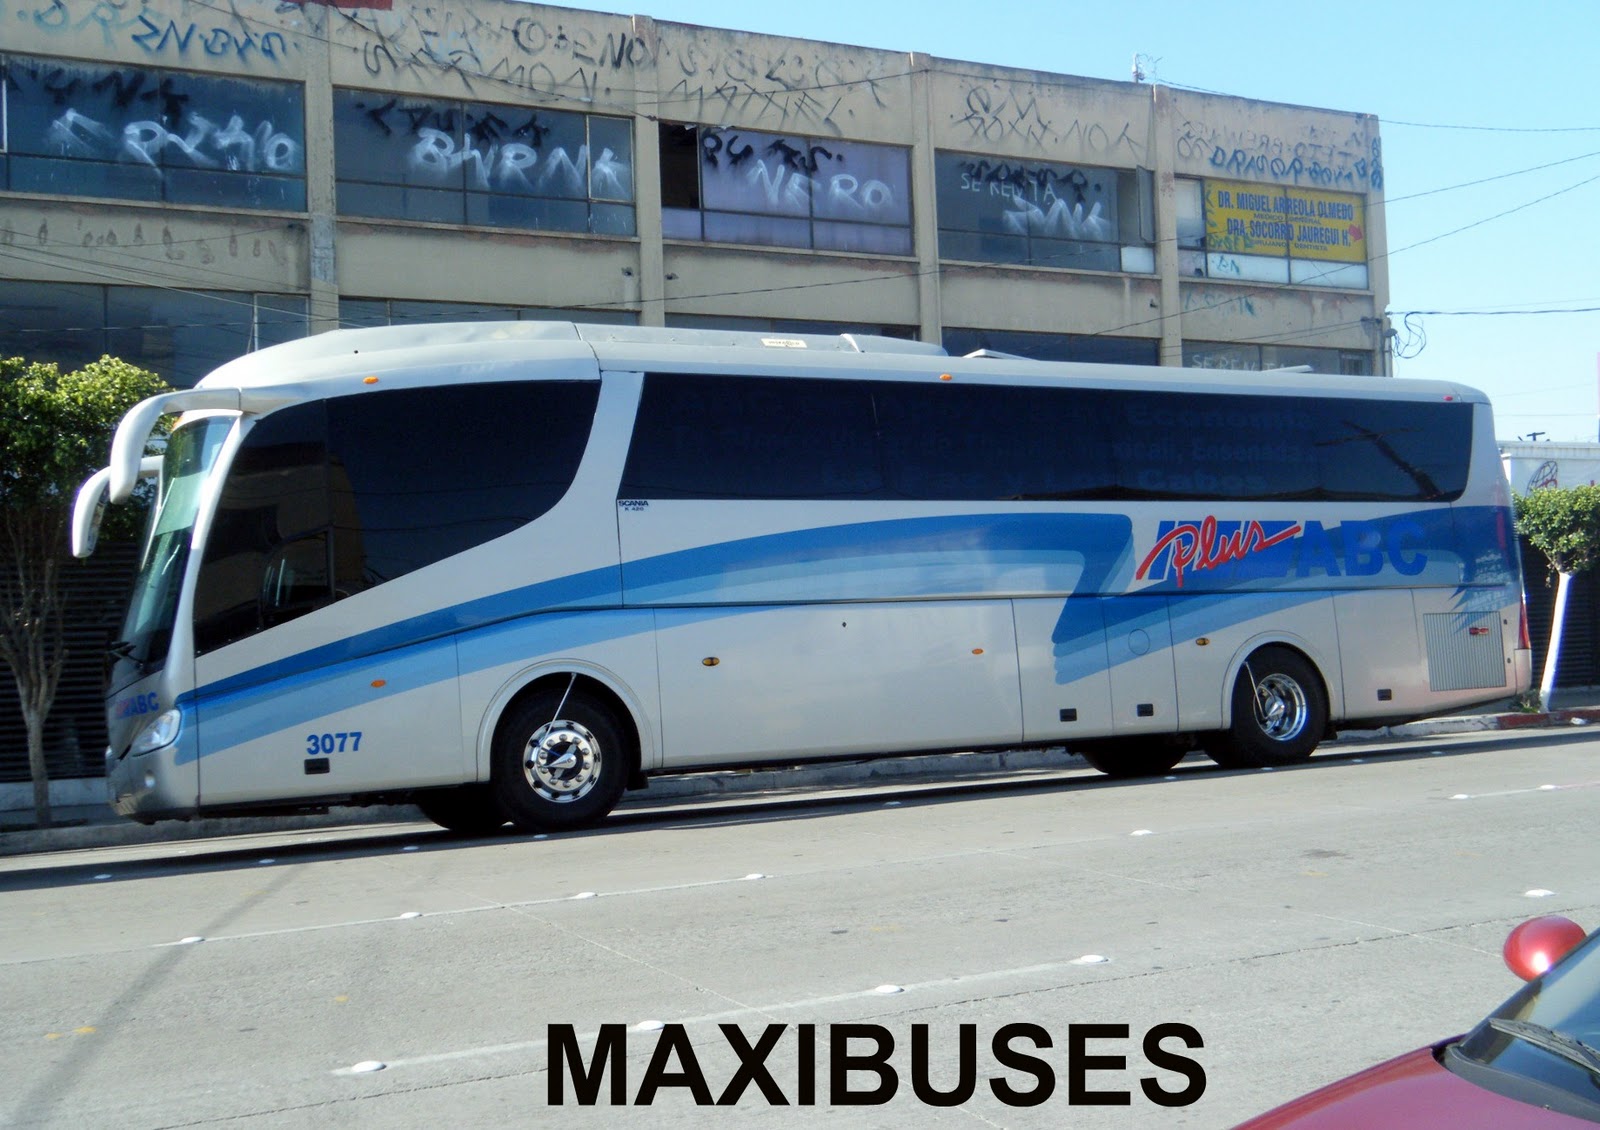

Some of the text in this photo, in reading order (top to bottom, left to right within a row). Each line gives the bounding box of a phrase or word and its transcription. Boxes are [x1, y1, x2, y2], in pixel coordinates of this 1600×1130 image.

[1218, 190, 1234, 209] DR.
[1237, 192, 1271, 213] MIGUEL
[1273, 195, 1315, 218] ARREOLA
[1317, 200, 1354, 221] OLMEDO
[1226, 217, 1248, 237] DRA.
[1249, 220, 1294, 241] SOCORRO
[1297, 224, 1340, 246] JAUREGUI
[1136, 515, 1428, 588] Plus ABC
[306, 731, 363, 755] 3077
